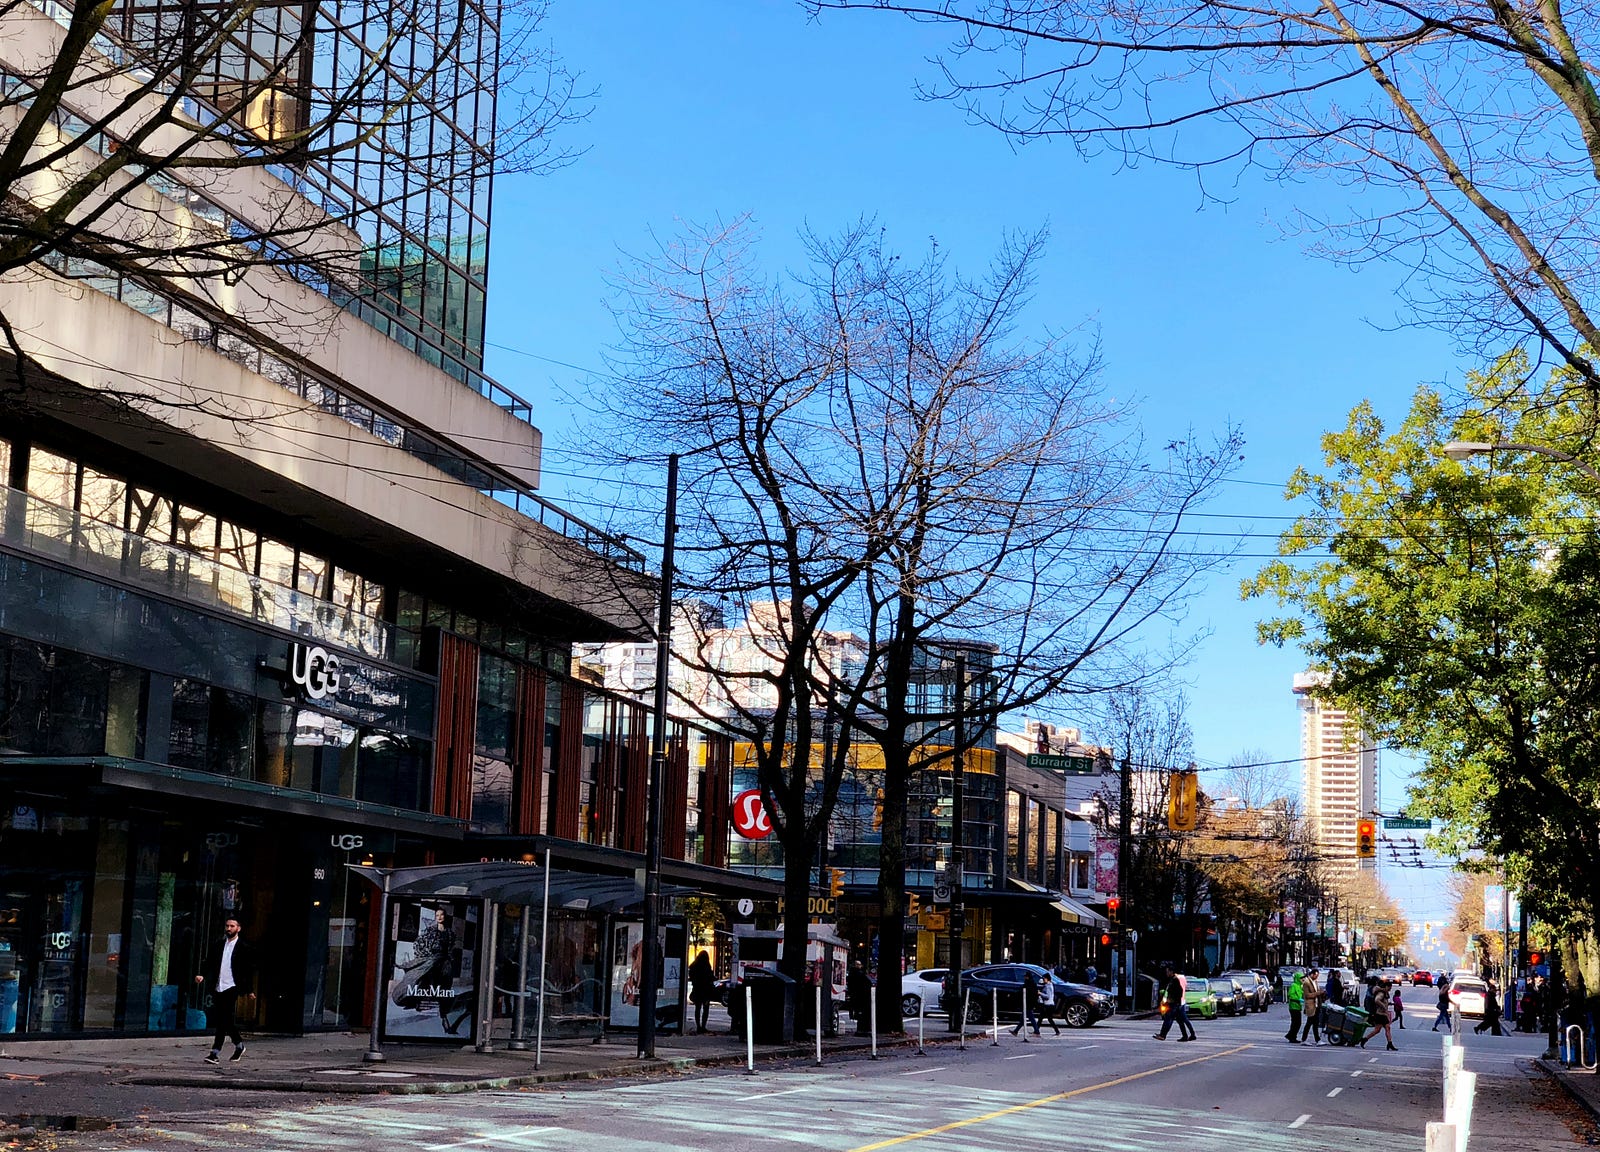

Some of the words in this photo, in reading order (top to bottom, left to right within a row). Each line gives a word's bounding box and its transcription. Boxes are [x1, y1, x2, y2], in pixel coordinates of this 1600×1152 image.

[292, 642, 341, 700] UGG
[1030, 755, 1072, 768] Burrard
[1076, 758, 1089, 769] St
[330, 834, 363, 850] UGG
[314, 868, 325, 880] 960
[808, 897, 836, 914] DOG
[51, 932, 71, 950] UGG
[406, 985, 455, 998] MaxMara
